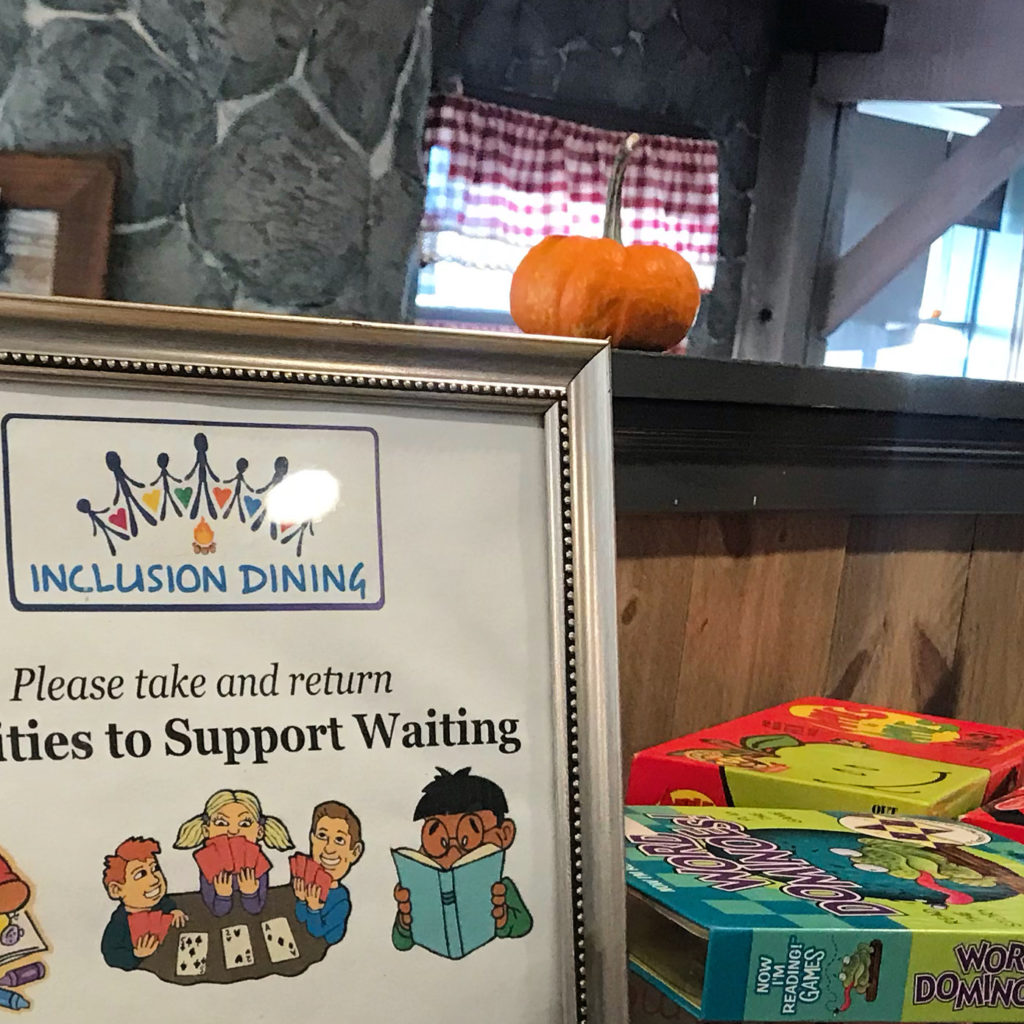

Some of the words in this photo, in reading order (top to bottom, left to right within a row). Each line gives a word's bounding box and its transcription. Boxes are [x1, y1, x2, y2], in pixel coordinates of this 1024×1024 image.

[30, 563, 228, 595] INCLUSION
[240, 562, 367, 600] DINING
[10, 666, 125, 702] Please
[134, 664, 208, 699] take
[216, 663, 280, 698] and
[289, 666, 394, 697] return
[105, 723, 152, 759] to
[164, 714, 345, 765] Support
[352, 708, 522, 754] Waiting
[756, 955, 773, 994] NOW
[772, 964, 786, 985] I'M
[798, 948, 825, 1002] GAMES
